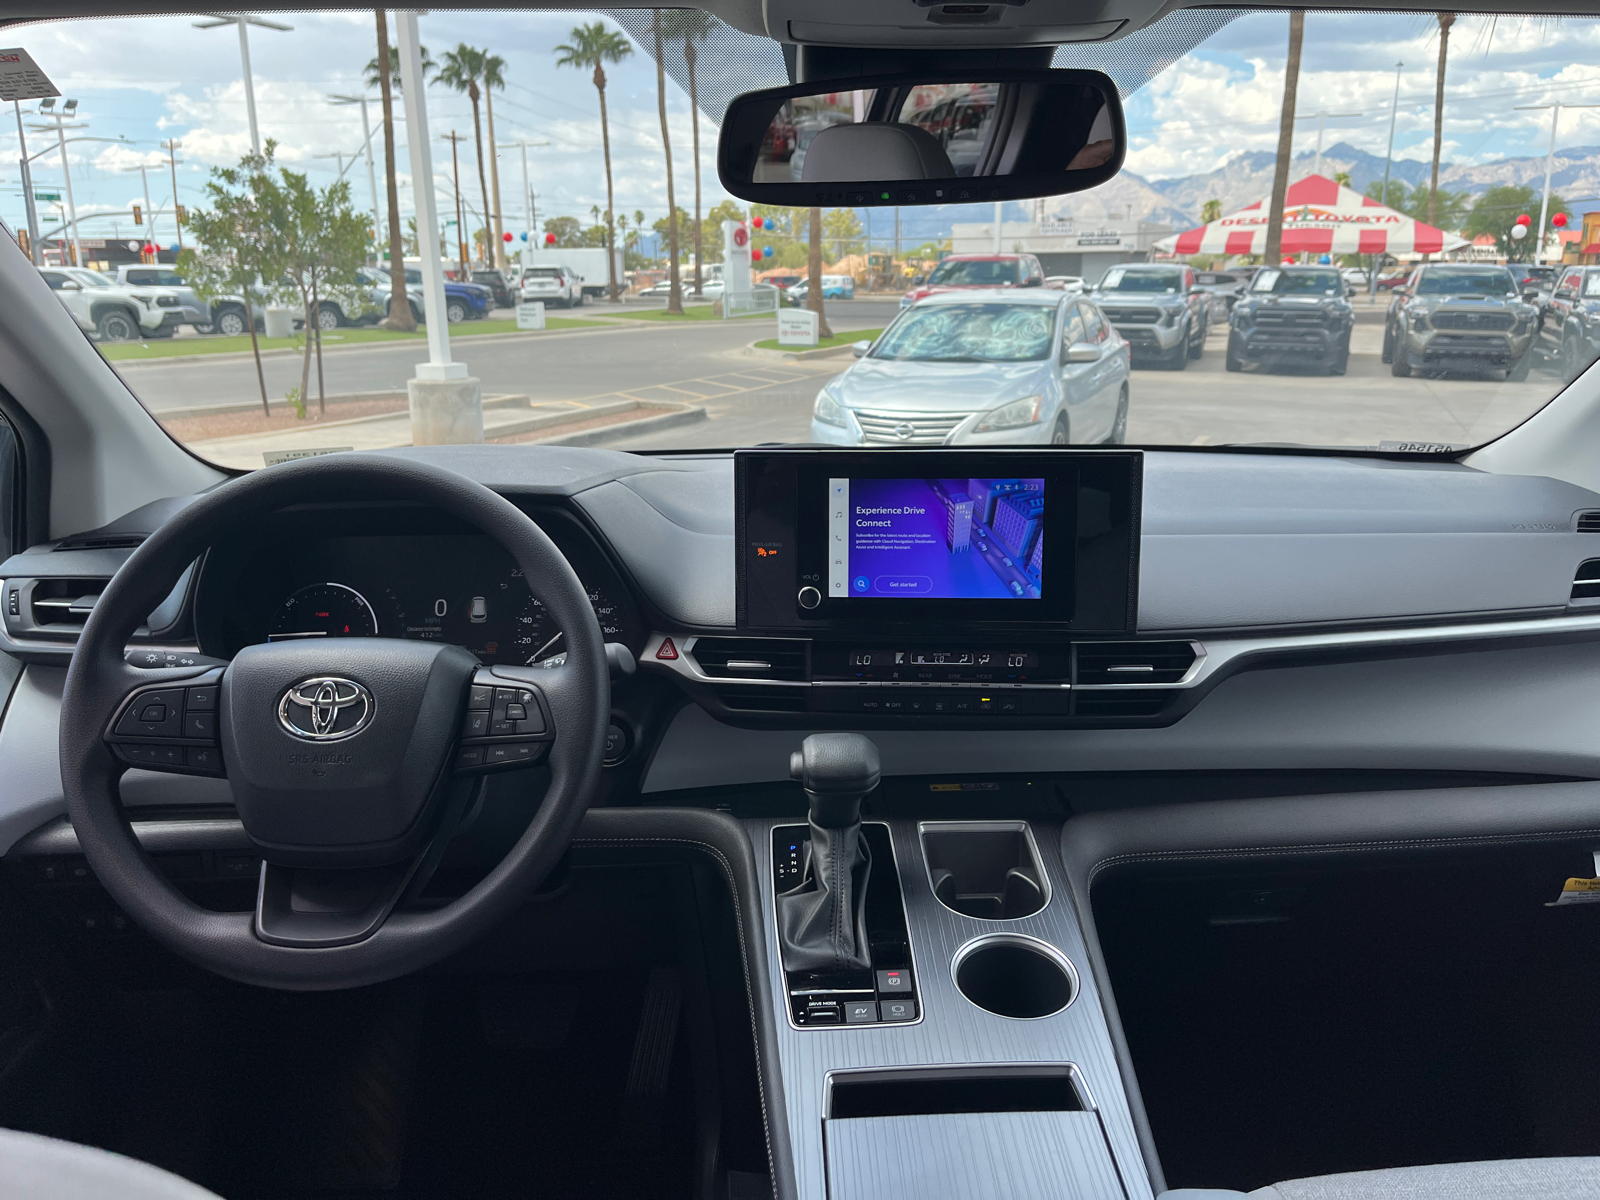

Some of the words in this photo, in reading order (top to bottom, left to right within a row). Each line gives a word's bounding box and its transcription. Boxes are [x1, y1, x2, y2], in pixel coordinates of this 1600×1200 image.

[1314, 214, 1400, 223] TOYOTA
[1023, 483, 1039, 491] 2:23
[856, 506, 902, 516] Experience
[903, 506, 926, 515] Drive
[855, 519, 892, 527] Connect
[511, 568, 525, 577] 2:2
[285, 597, 296, 608] ECO
[354, 596, 364, 607] PWR
[434, 598, 447, 617] 0
[522, 616, 533, 624] 40
[603, 626, 616, 634] 160
[856, 654, 872, 665] LO
[934, 655, 945, 663] LO
[1008, 656, 1023, 667] LO
[289, 754, 309, 764] SRS
[312, 754, 353, 765] AIRBAG
